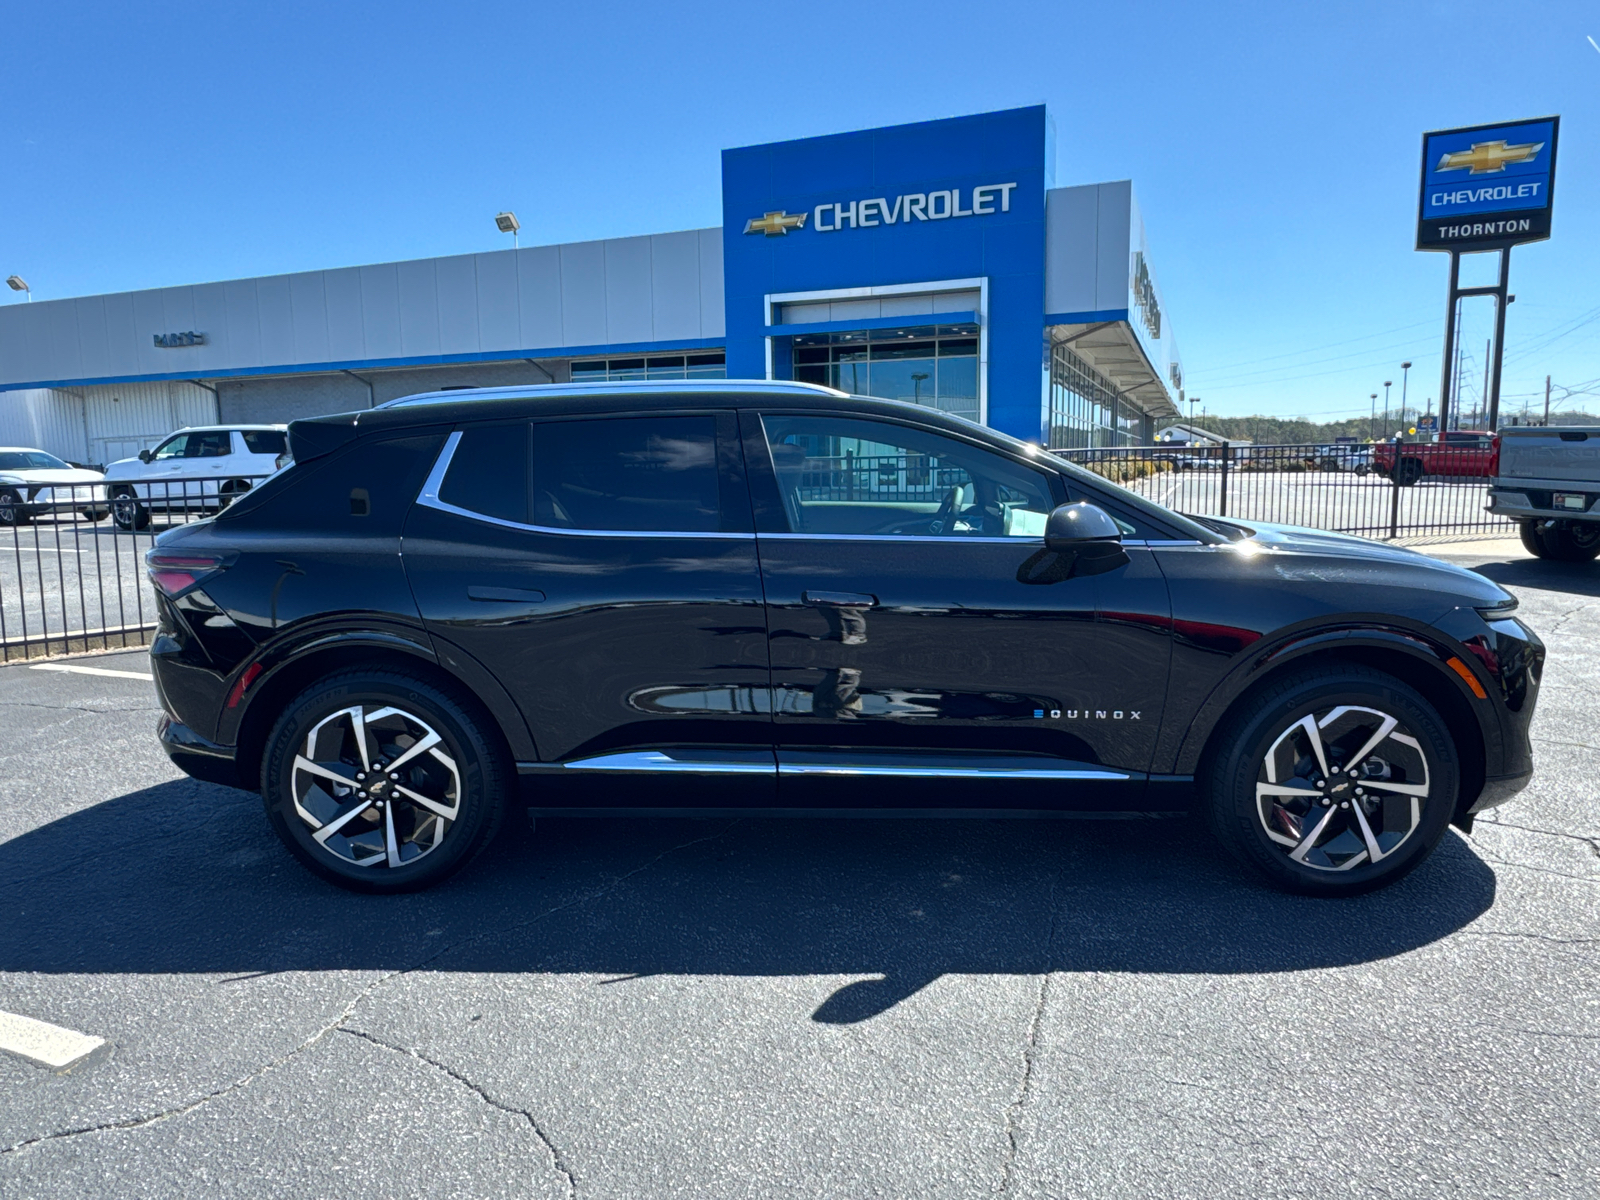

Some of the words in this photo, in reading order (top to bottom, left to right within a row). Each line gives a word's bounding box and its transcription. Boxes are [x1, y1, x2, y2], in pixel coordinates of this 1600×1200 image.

[1431, 182, 1541, 206] CHEVROLET
[814, 182, 1017, 232] CHEVROLET
[1438, 219, 1530, 239] THORNTON
[1033, 709, 1141, 719] EQUINOX
